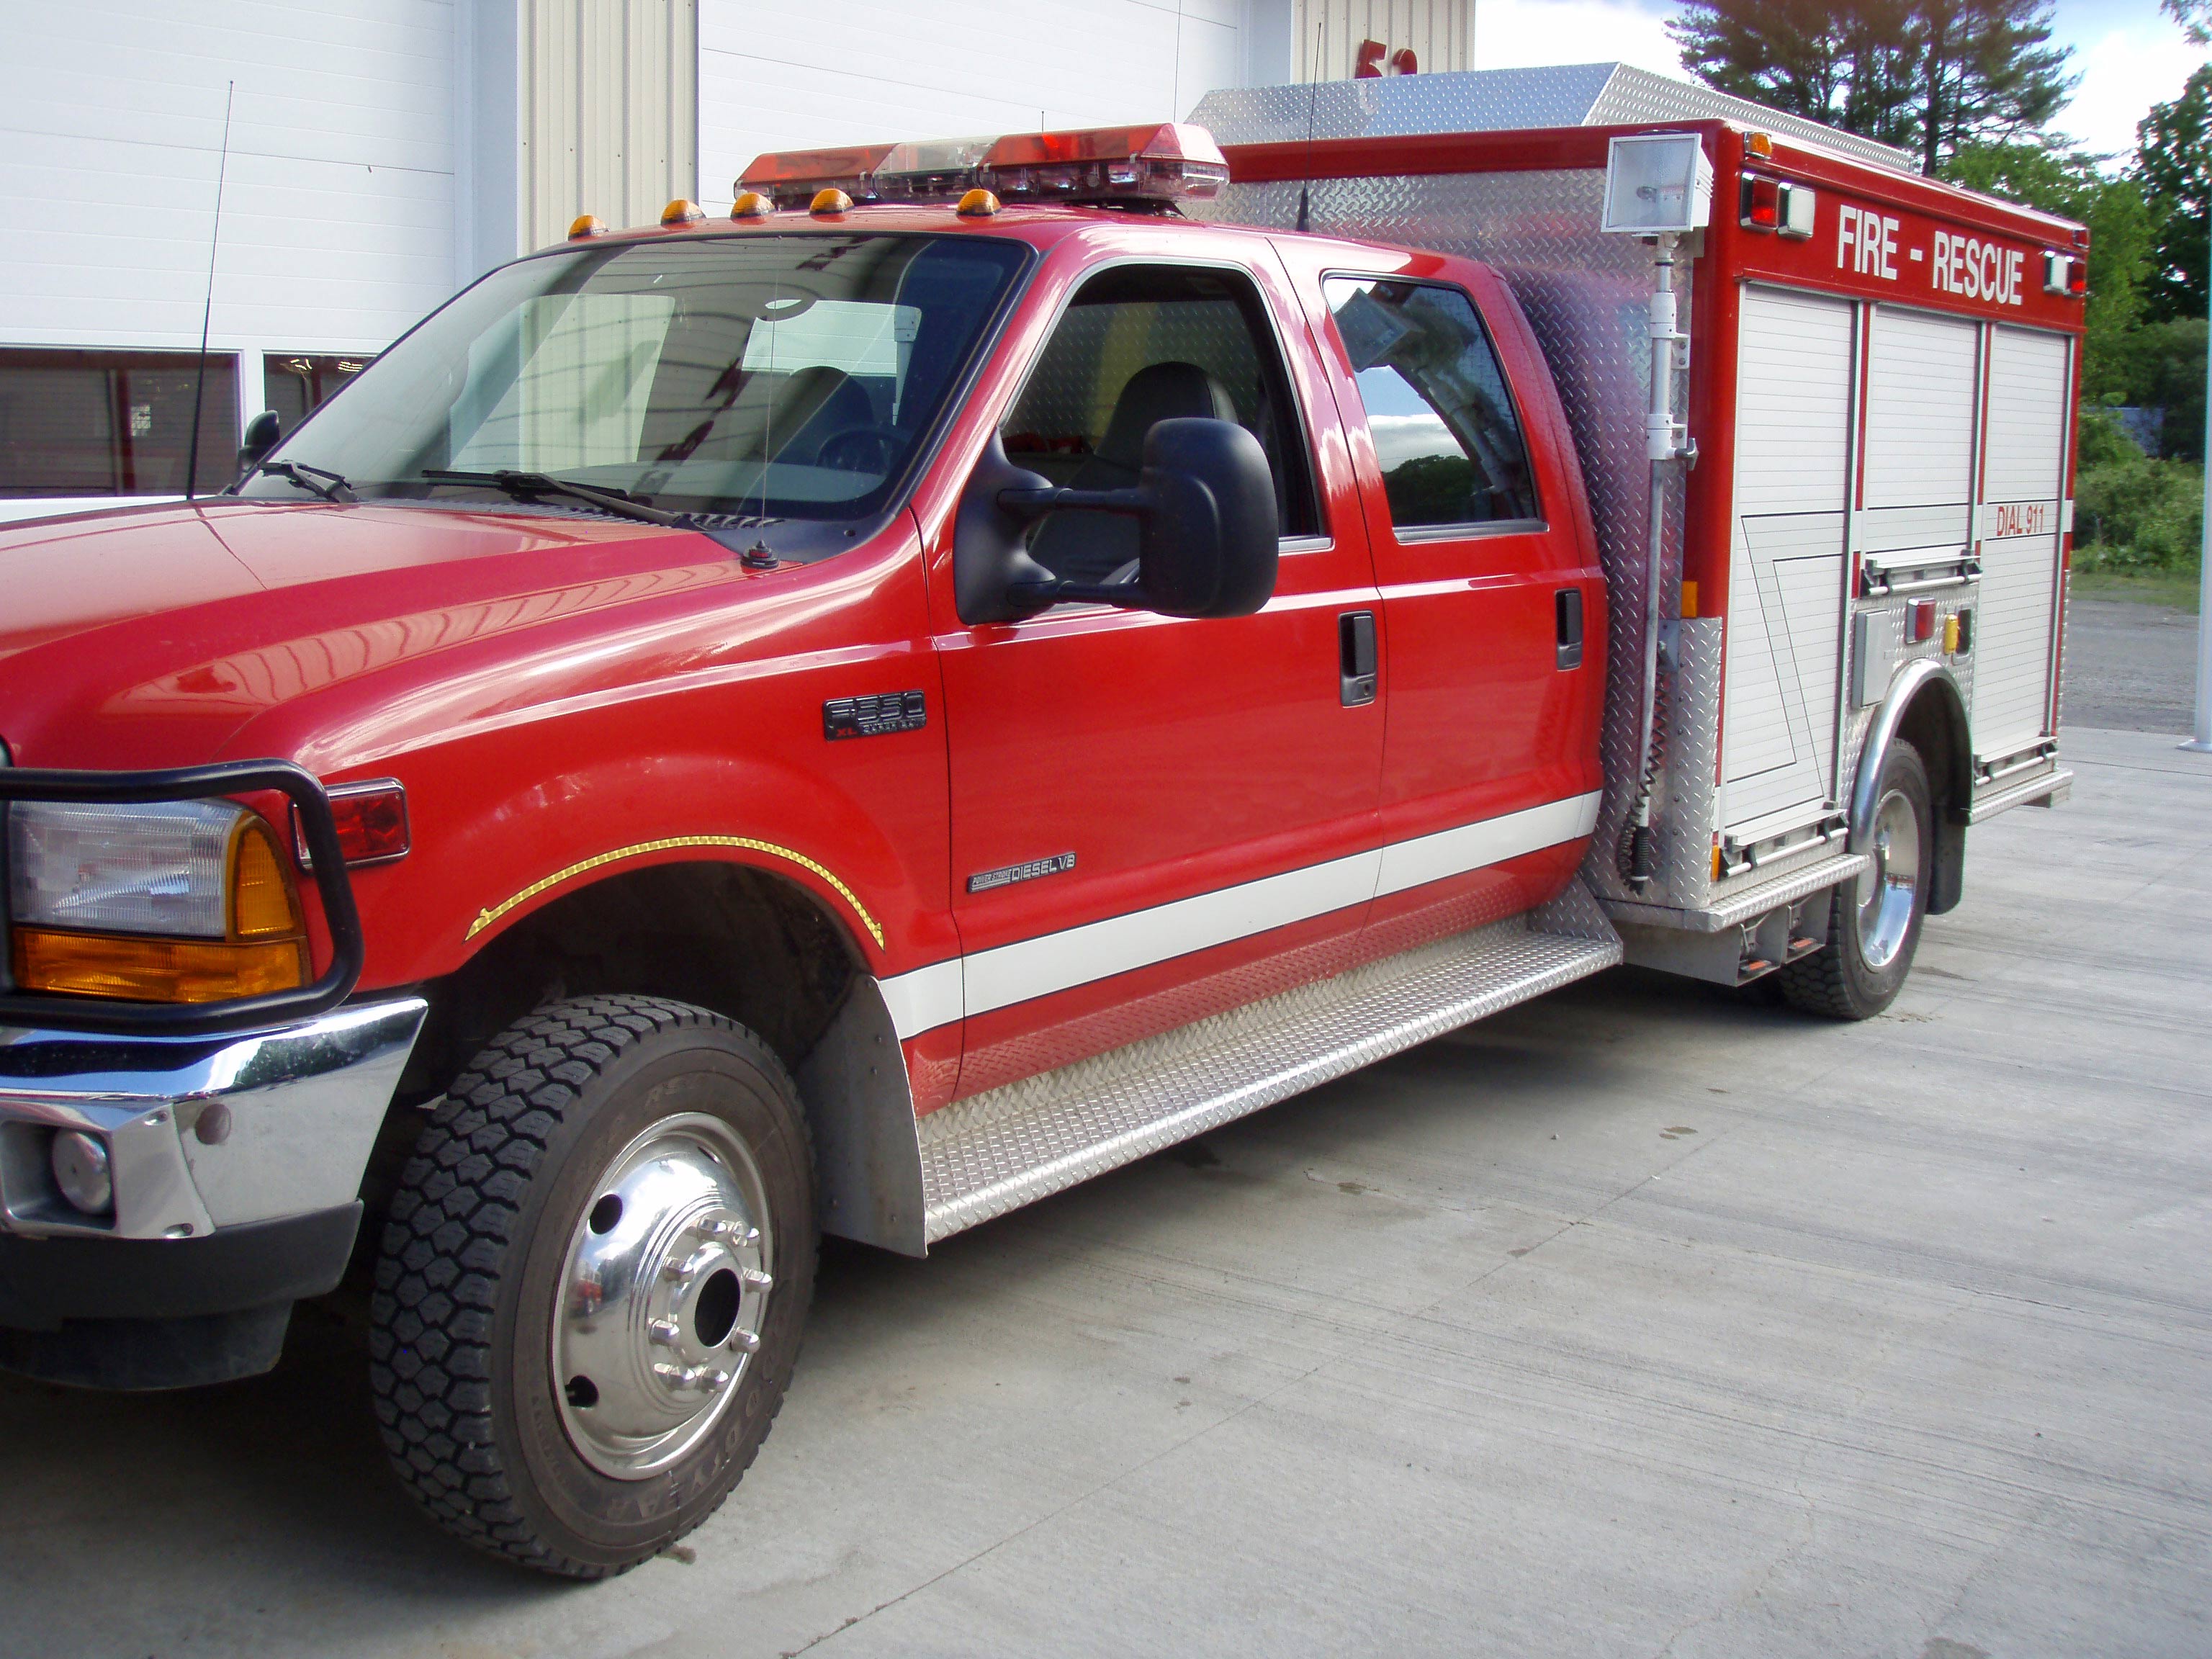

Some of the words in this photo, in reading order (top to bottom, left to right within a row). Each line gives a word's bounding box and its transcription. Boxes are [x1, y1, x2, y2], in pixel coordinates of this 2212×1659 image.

[1838, 204, 1899, 280] FIRE
[1933, 230, 2024, 305] RESCUE
[1997, 505, 2023, 536] DIAL
[2026, 504, 2044, 534] 911
[1012, 859, 1057, 881] DIESEL
[1058, 854, 1076, 870] V8
